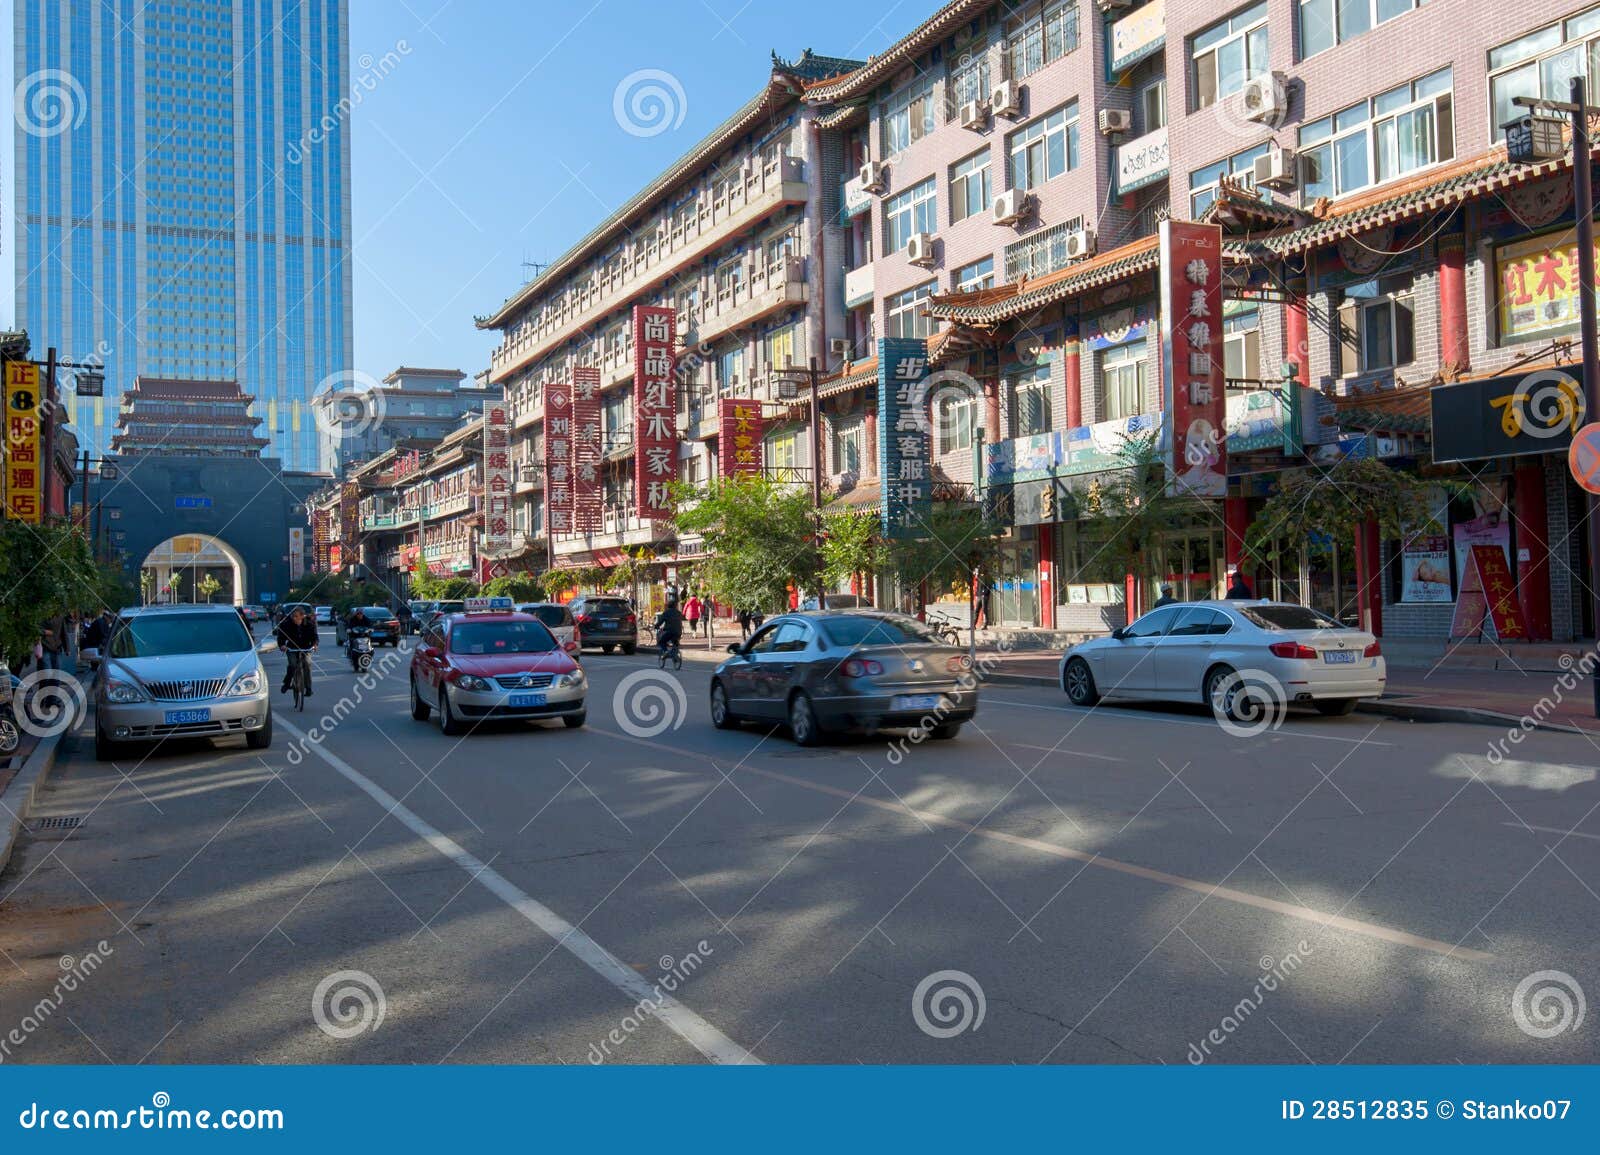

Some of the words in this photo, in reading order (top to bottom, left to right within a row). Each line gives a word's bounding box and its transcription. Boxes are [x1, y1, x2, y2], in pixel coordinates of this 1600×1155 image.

[644, 314, 673, 510] 尚品红木家私
[468, 599, 489, 607] TAXI
